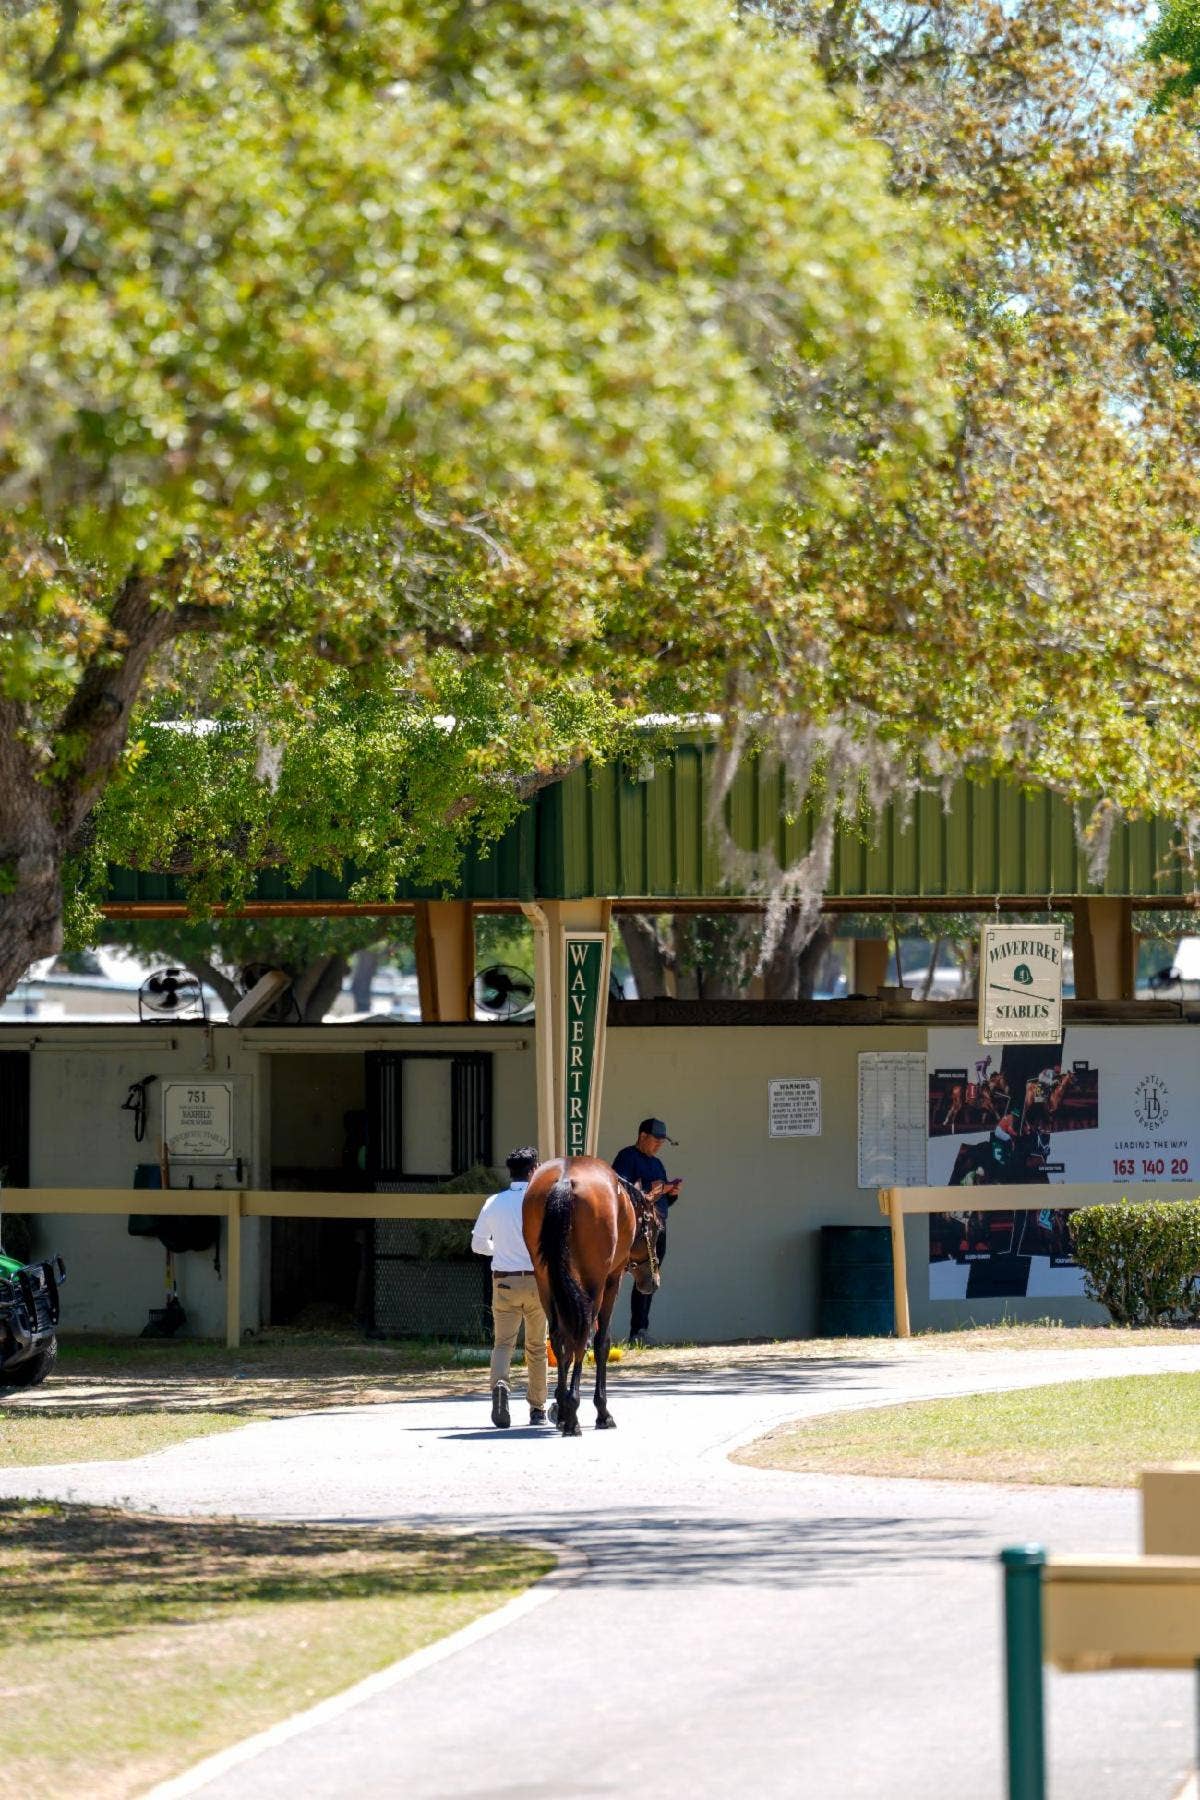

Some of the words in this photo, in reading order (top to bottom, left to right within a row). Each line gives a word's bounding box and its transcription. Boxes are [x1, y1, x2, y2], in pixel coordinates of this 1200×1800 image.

[990, 941, 1059, 965] WAVERTREE
[996, 1005, 1049, 1019] STABLES
[187, 1091, 206, 1103] 751
[1154, 1141, 1168, 1149] THE
[1170, 1140, 1188, 1149] WAY
[1113, 1160, 1135, 1175] 163
[1142, 1159, 1165, 1175] 140
[1171, 1158, 1188, 1175] 20
